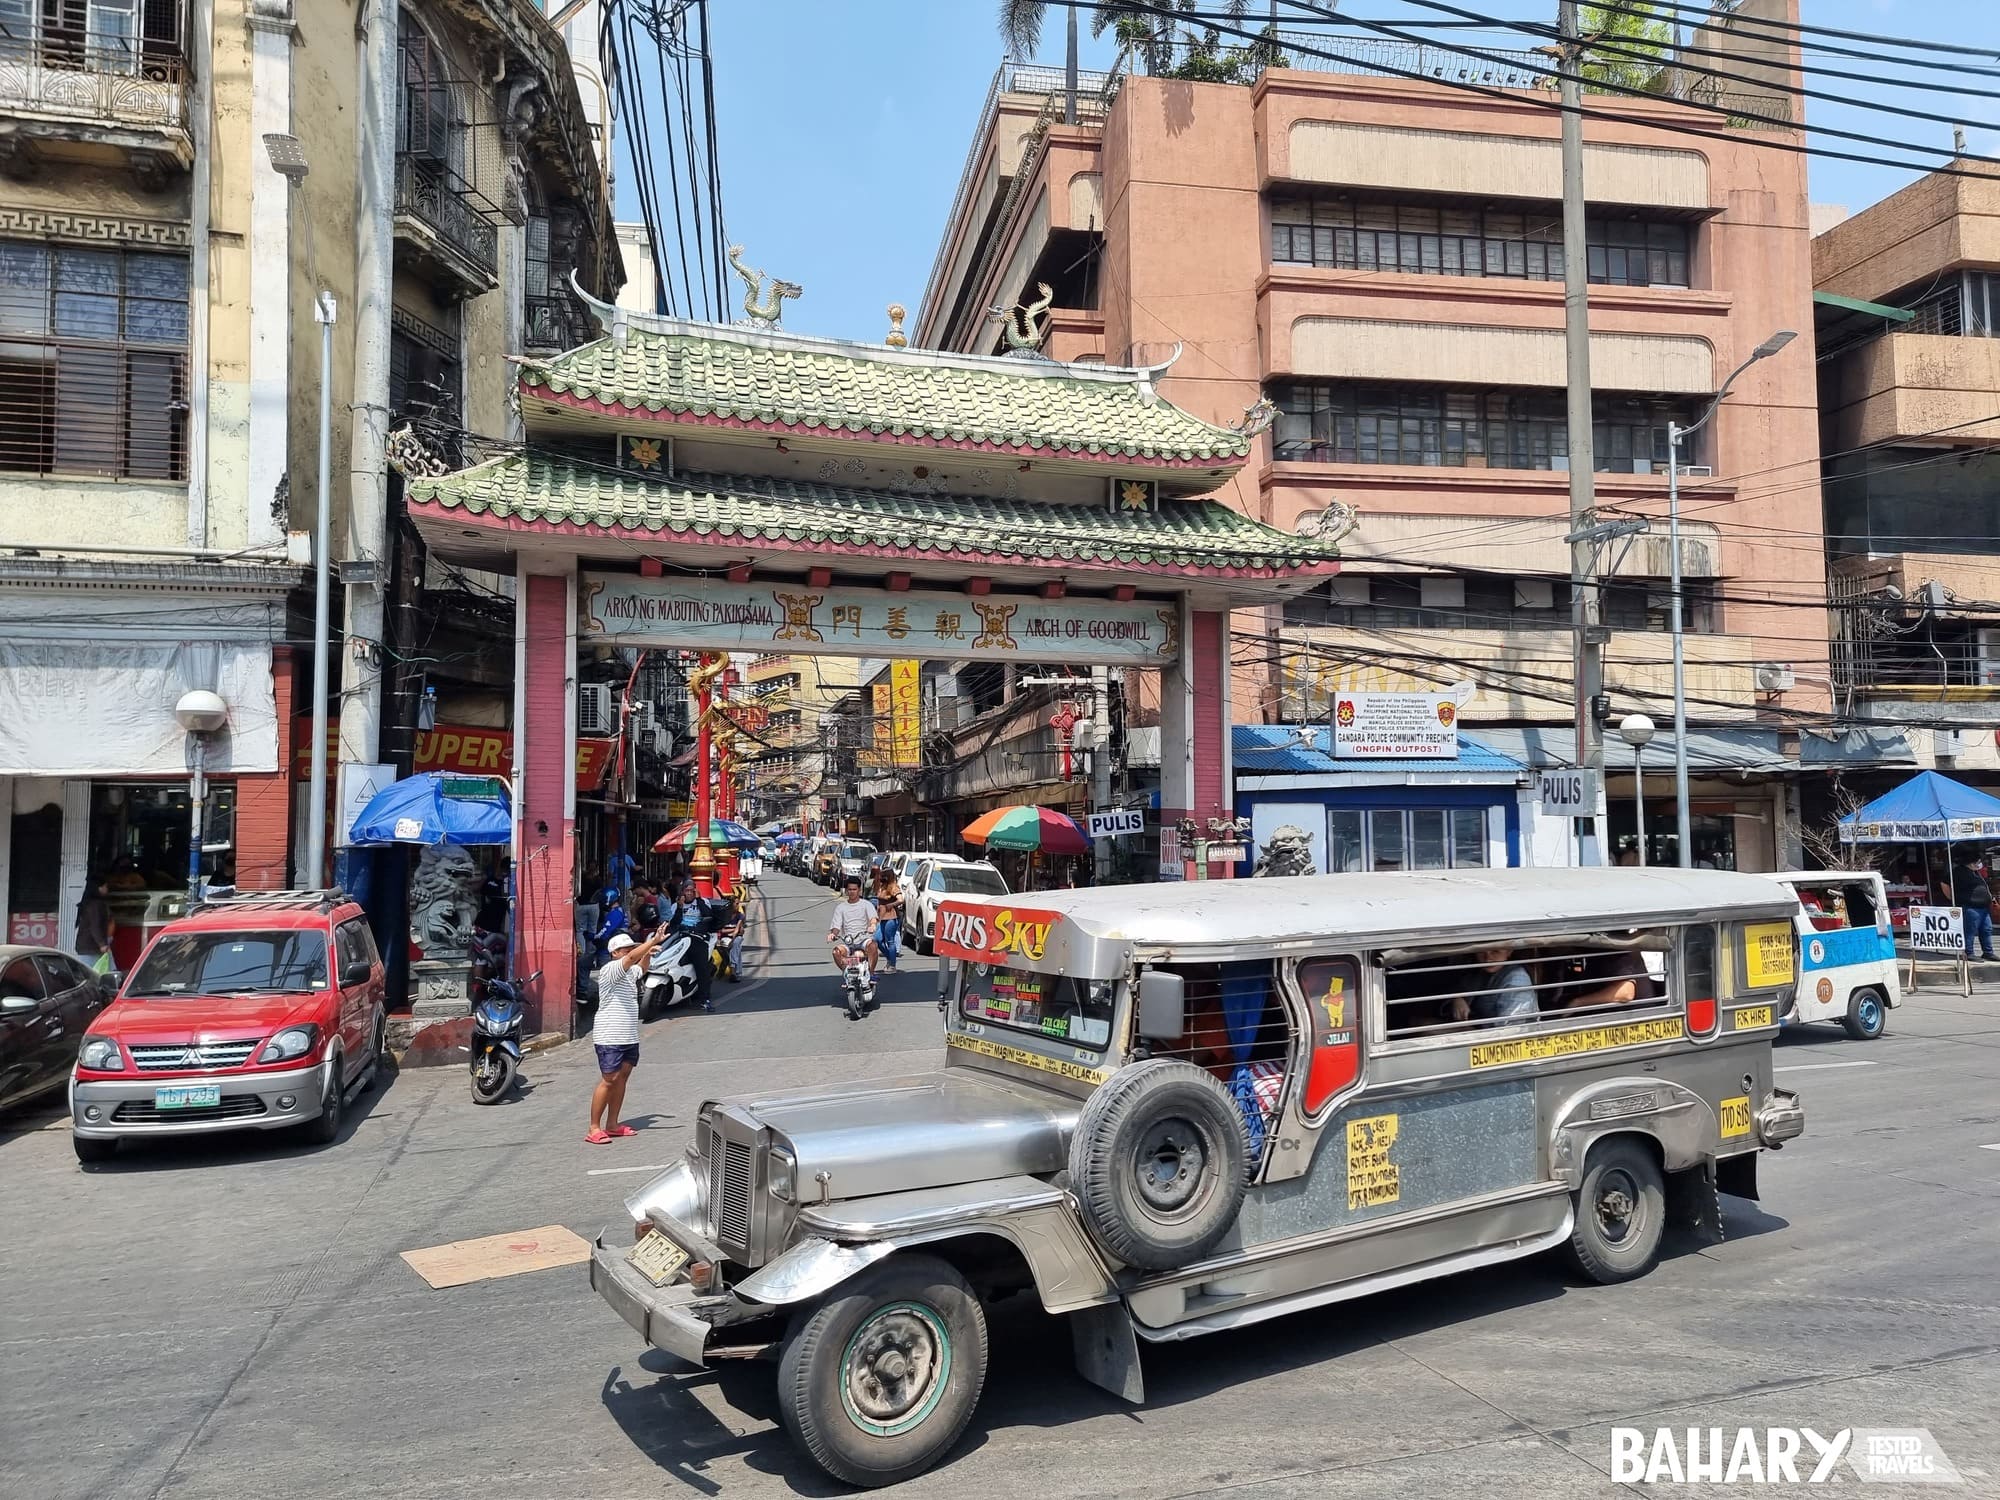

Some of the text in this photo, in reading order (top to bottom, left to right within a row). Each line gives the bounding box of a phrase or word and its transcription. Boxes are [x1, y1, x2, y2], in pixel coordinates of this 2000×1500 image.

[604, 598, 774, 626] ARKO NG MABUTING PAKIKISAMA
[1026, 618, 1150, 641] ARCH OF GOODWILL
[1338, 733, 1454, 743] GANDARA POLICE COMMUNITY PRECINCT
[415, 732, 503, 769] UPER
[1352, 745, 1442, 753] (ONGPIN OUTPOST)
[1543, 777, 1581, 804] PULIS
[1092, 814, 1142, 833] PULIS
[941, 911, 988, 950] YRIS
[1925, 916, 1949, 931] NO
[1912, 932, 1963, 948] PARKING
[1016, 983, 1041, 993] KALAW
[1737, 1009, 1766, 1026] FOR HIRE
[1645, 1019, 1680, 1040] BACLARAN
[994, 1045, 1015, 1060] MABINI
[1061, 1062, 1103, 1081] BACLARAN
[1722, 1105, 1735, 1129] TVD
